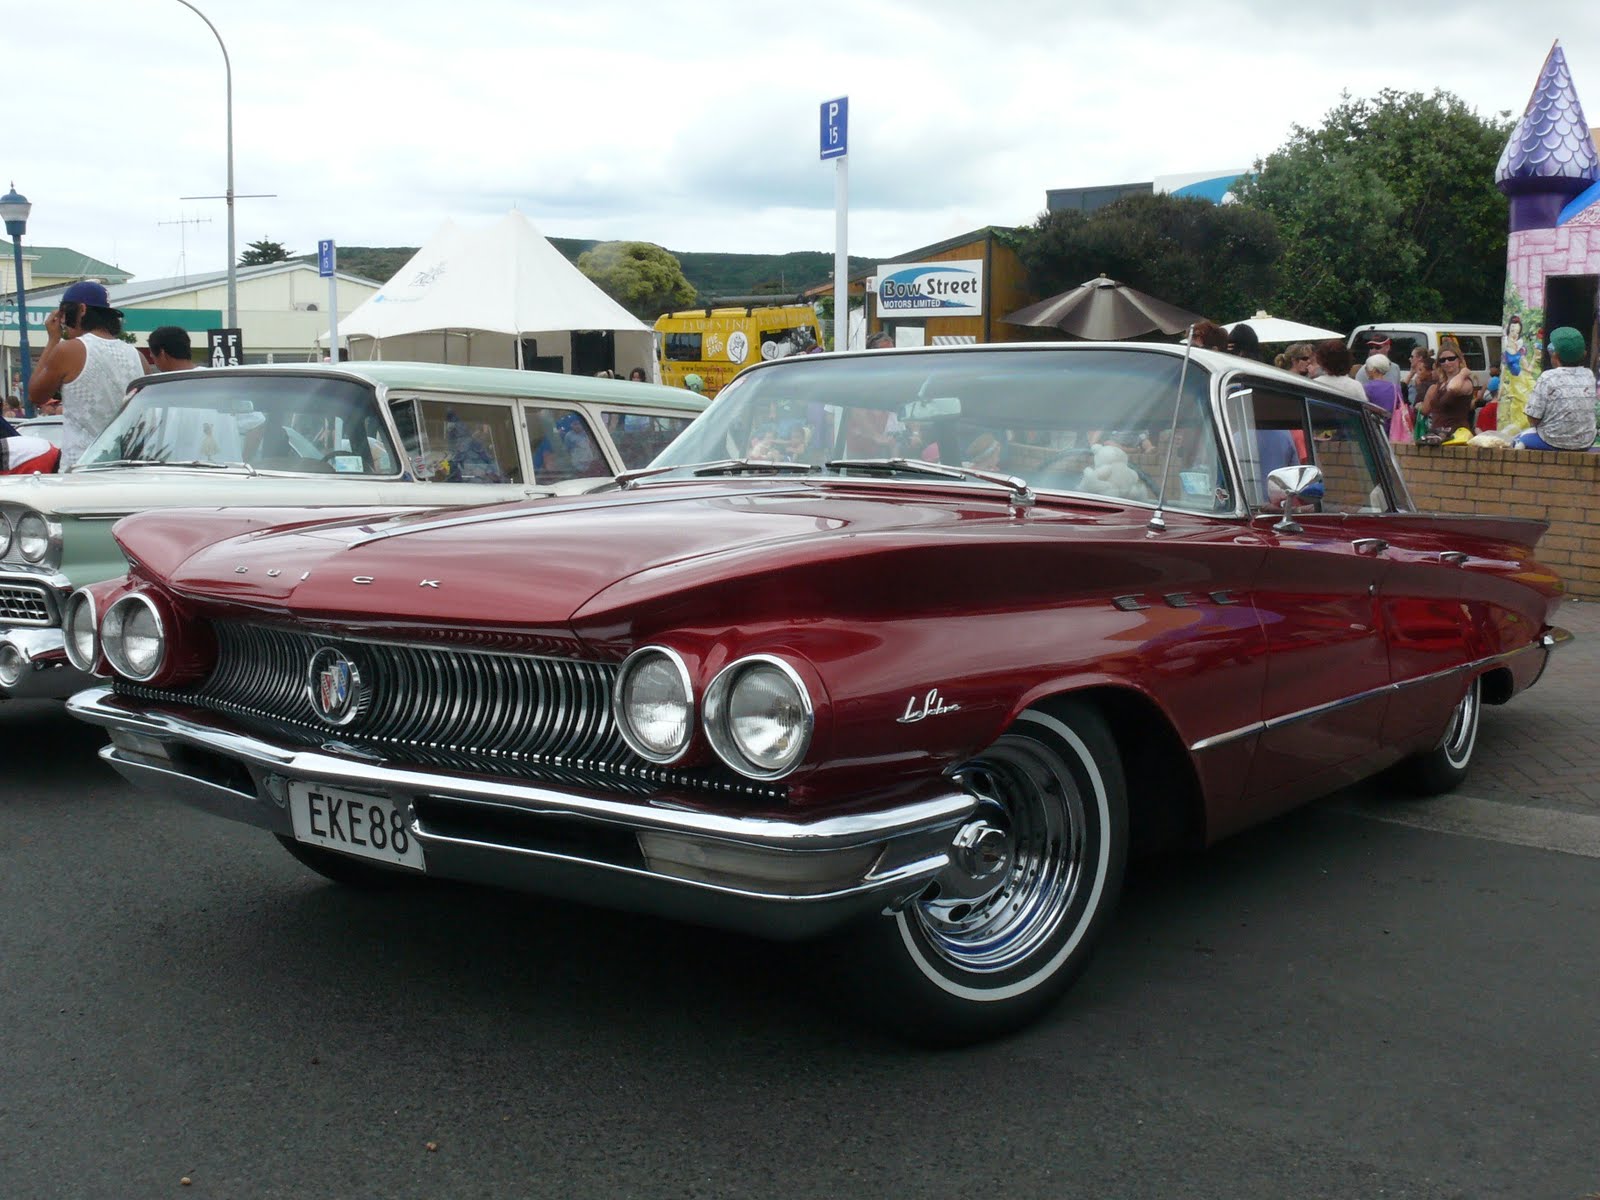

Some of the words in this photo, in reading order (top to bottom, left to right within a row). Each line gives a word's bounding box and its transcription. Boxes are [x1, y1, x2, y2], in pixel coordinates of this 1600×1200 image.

[829, 102, 839, 125] P
[829, 126, 838, 145] 15
[322, 241, 329, 257] P
[883, 279, 921, 298] Bow
[927, 277, 977, 295] Street
[883, 300, 912, 309] MOTORS
[913, 299, 941, 308] LIMITED
[308, 792, 409, 854] EKE88
